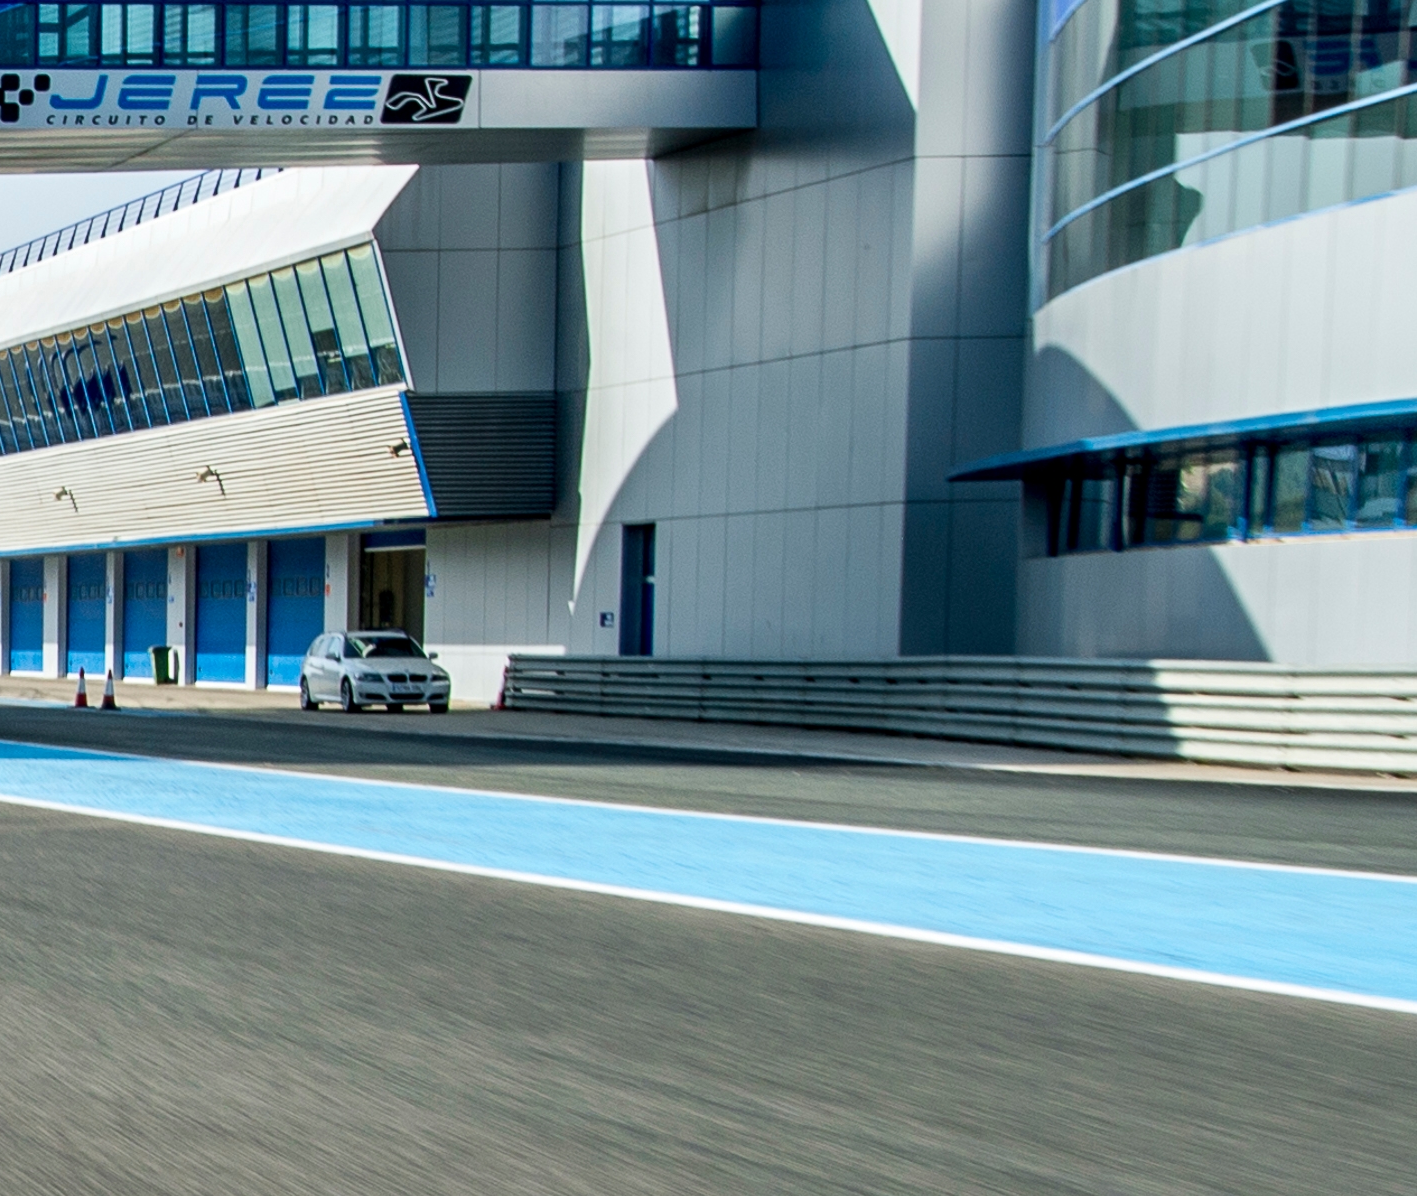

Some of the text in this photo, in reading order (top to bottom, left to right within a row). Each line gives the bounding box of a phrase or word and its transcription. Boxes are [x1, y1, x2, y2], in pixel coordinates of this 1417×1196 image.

[49, 74, 382, 111] JEREZ
[46, 115, 374, 126] CIRCUITO DE VELOCIDAD
